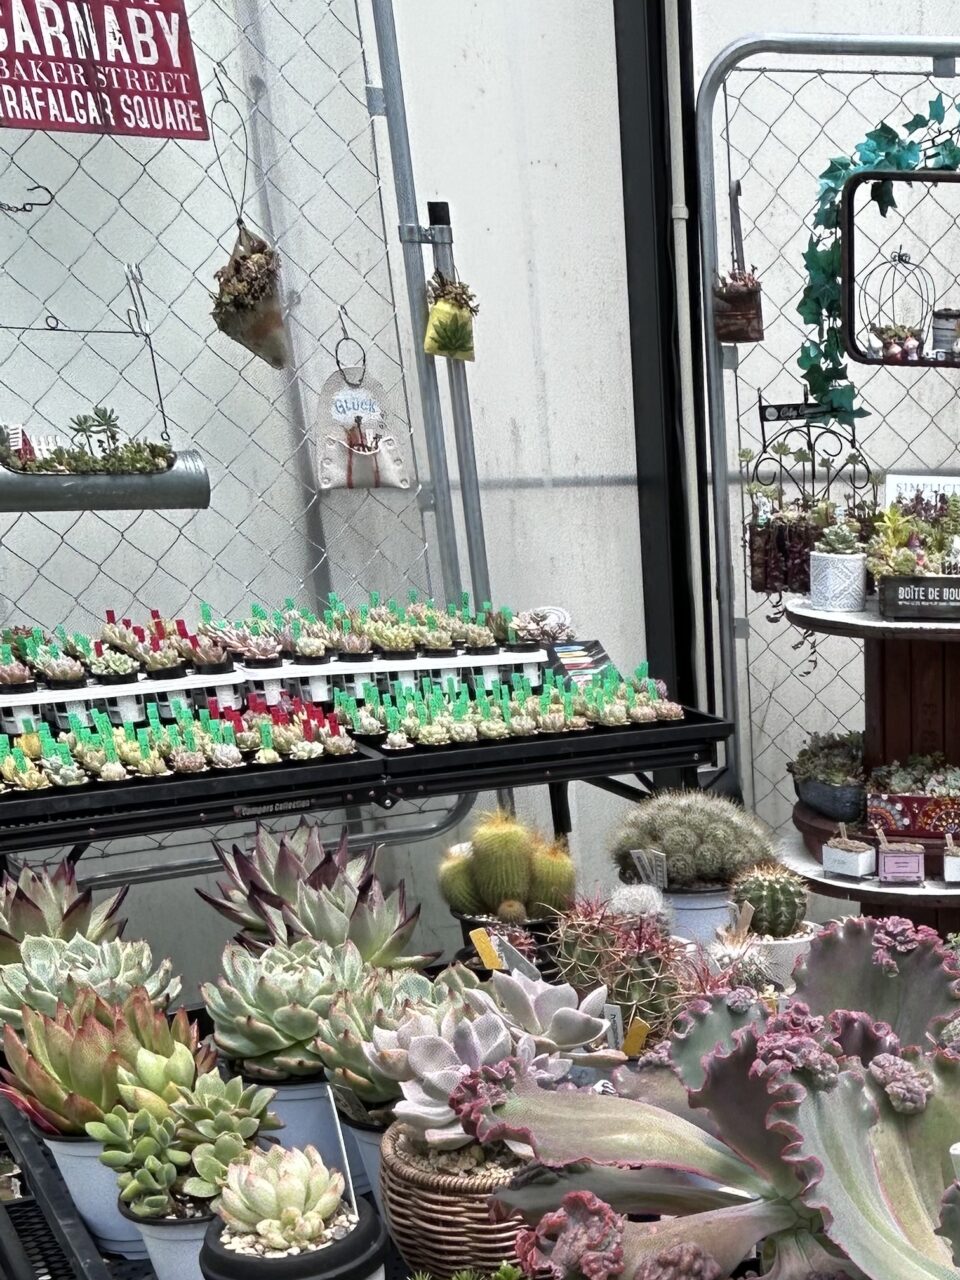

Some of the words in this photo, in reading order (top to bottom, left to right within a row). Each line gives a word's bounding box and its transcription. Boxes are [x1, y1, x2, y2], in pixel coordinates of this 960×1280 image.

[96, 65, 191, 95] STREET
[0, 84, 116, 126] RAFALGAR
[120, 94, 203, 132] SQUARE
[928, 587, 940, 600] DE
